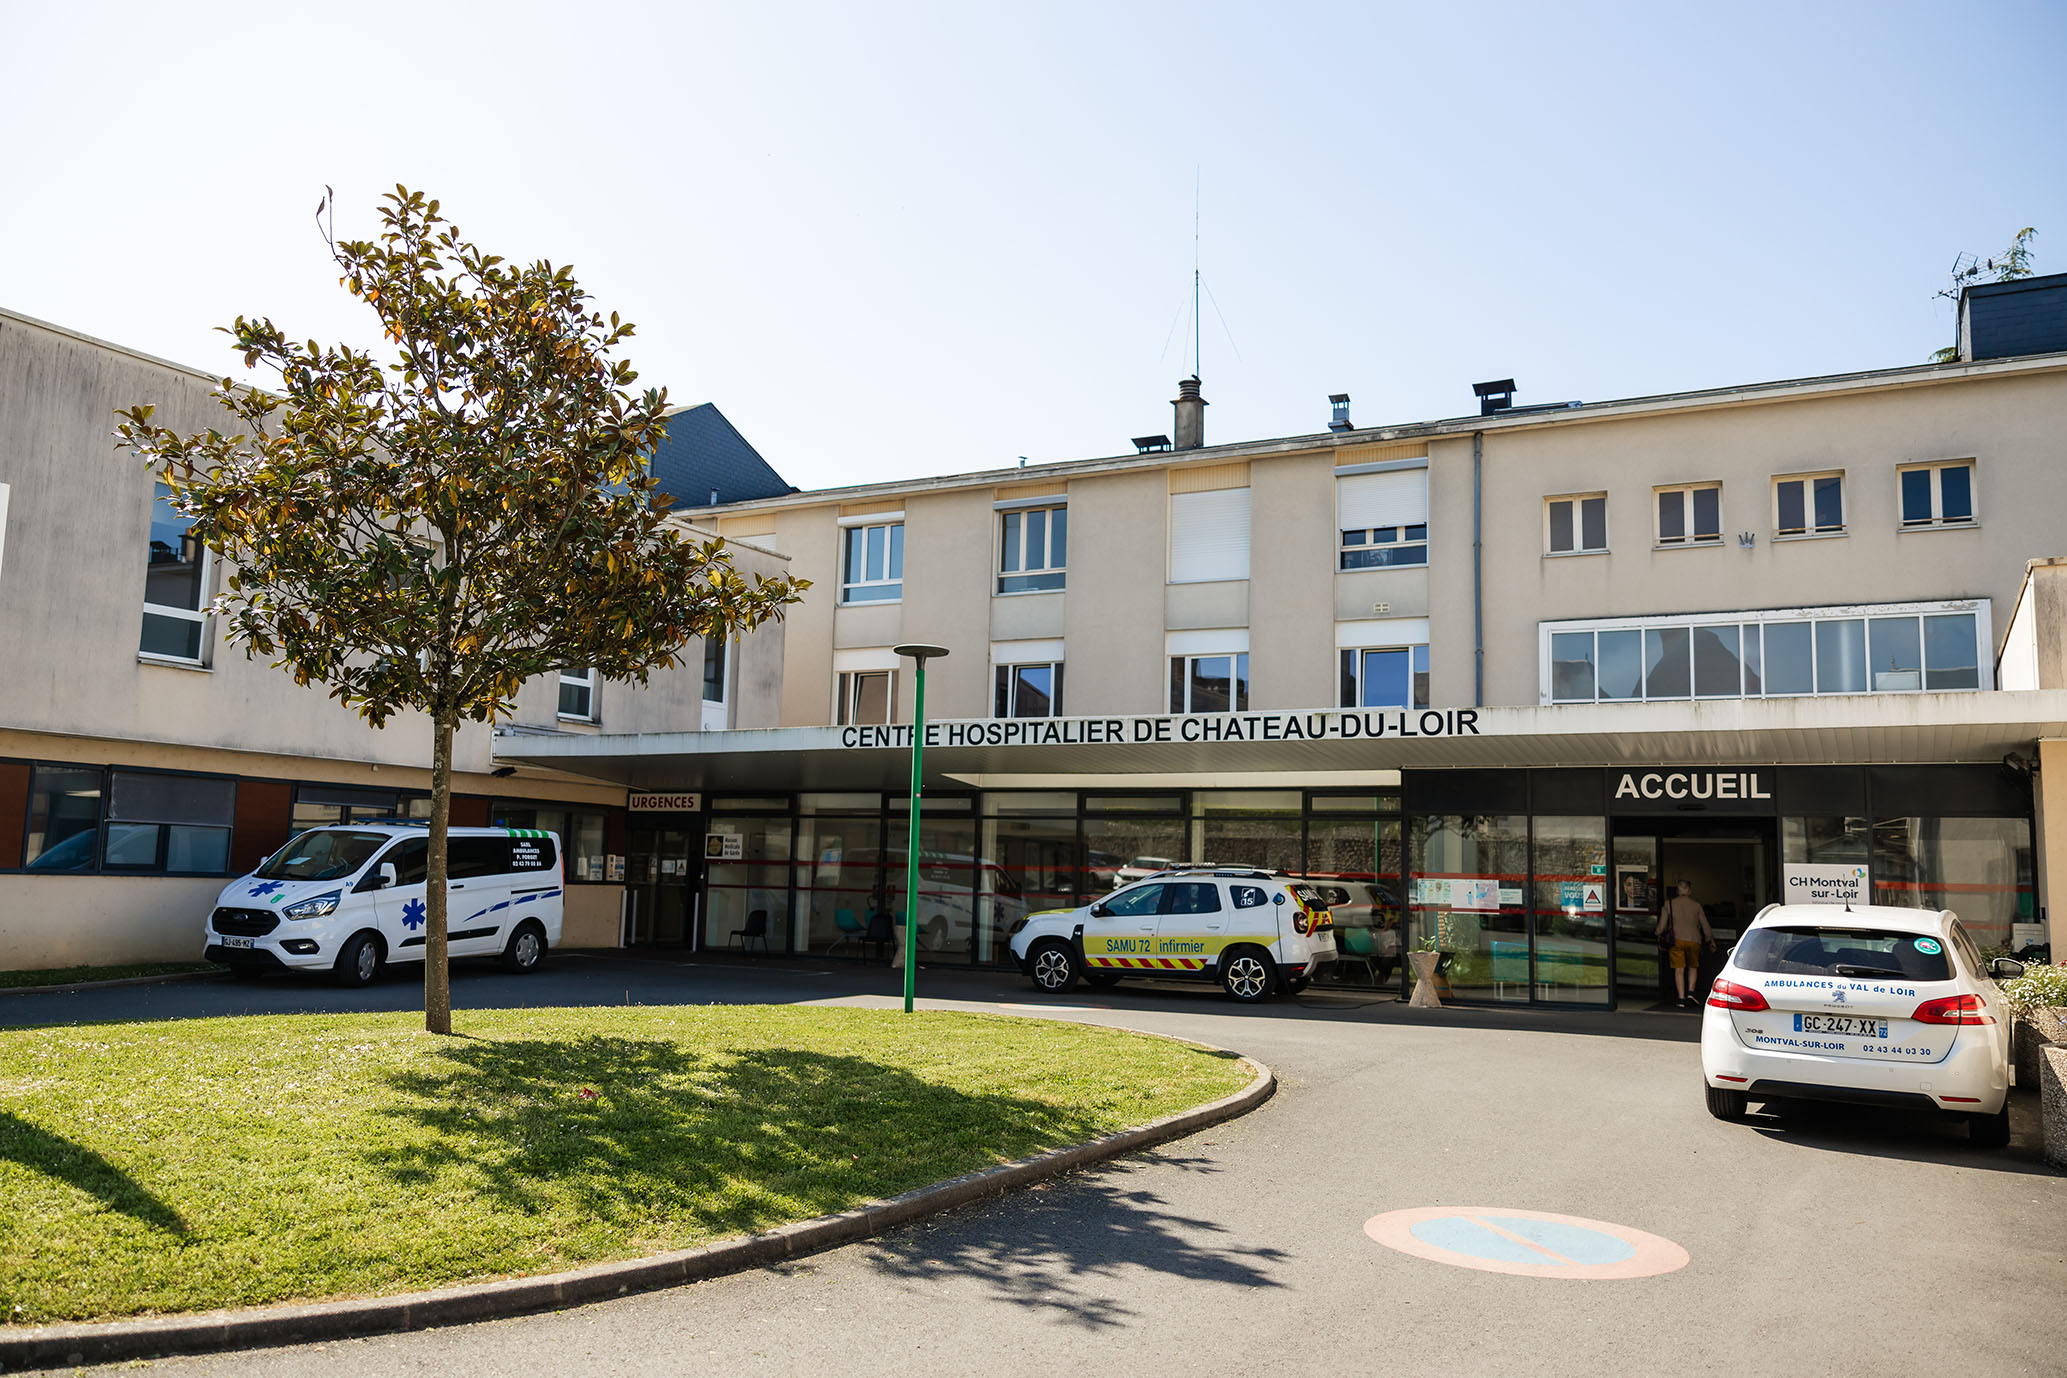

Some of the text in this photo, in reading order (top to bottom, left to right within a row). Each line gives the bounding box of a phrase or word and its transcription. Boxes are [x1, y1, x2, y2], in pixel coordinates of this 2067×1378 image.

[949, 721, 1124, 745] HOSPITALIER
[1134, 719, 1171, 742] DE
[1181, 710, 1480, 741] CHATEAU-DU-LOIR
[1614, 773, 1771, 799] ACCUEIL
[632, 796, 694, 808] URGENCES
[1789, 877, 1859, 887] CH Montval
[1106, 939, 1205, 953] SAMU 72 infirmier
[1764, 980, 1833, 989] AMBULANCES
[1850, 984, 1869, 992] VAL
[1873, 985, 1885, 993] de
[1890, 987, 1916, 997] LOIR
[1879, 1029, 1888, 1037] 72
[1755, 1035, 1845, 1050] MONTVAL-SUR-LOIR
[1920, 1048, 1931, 1056] 30
